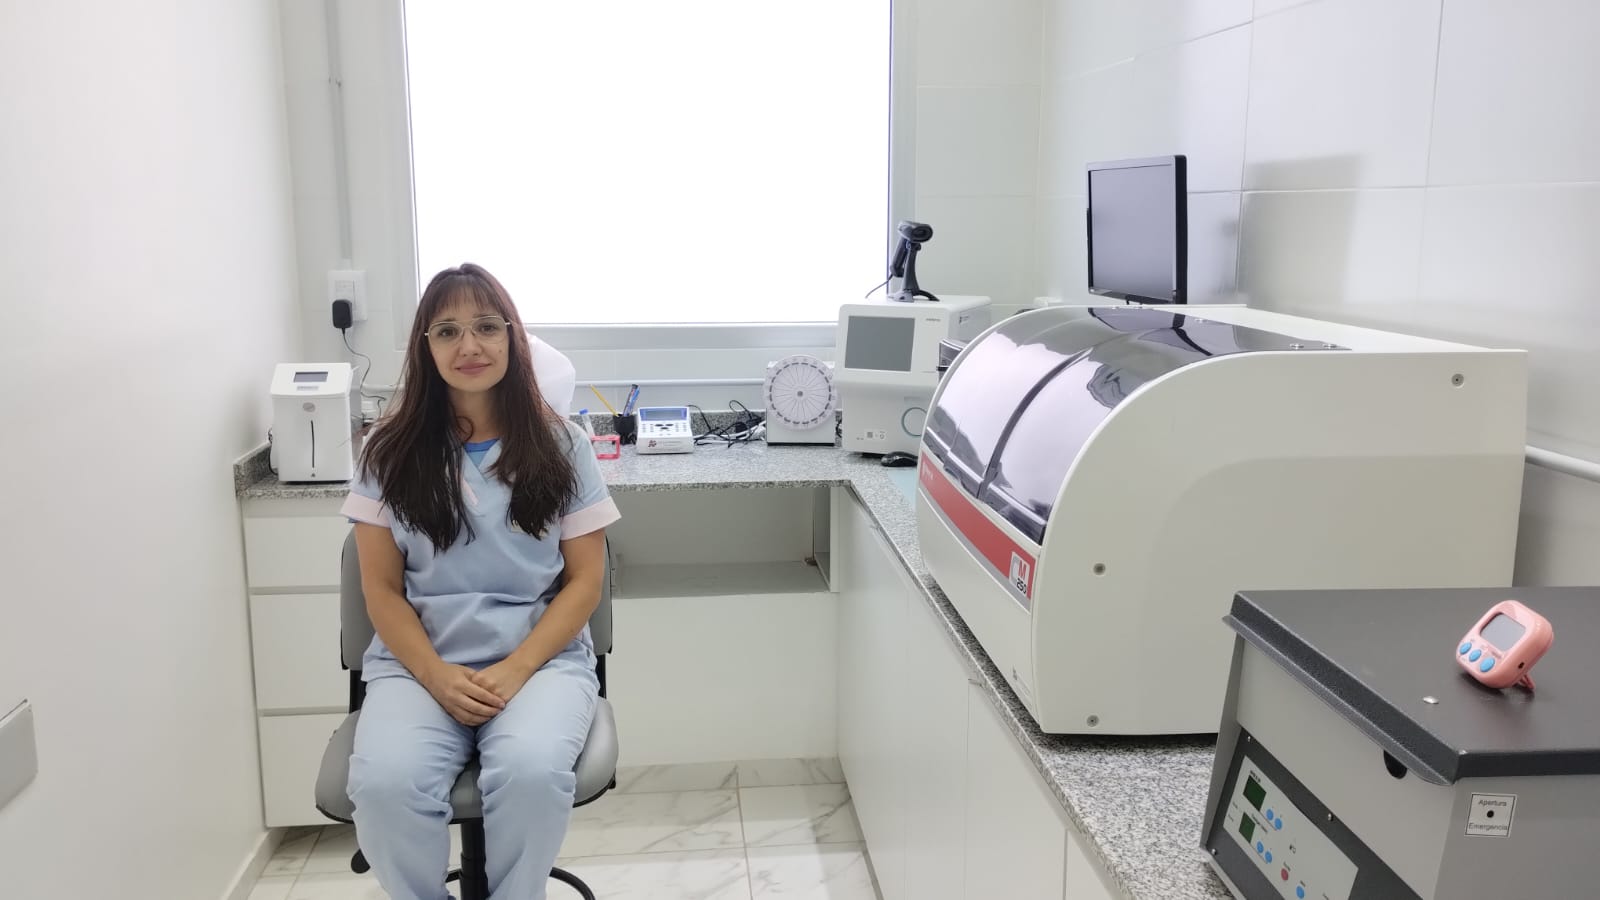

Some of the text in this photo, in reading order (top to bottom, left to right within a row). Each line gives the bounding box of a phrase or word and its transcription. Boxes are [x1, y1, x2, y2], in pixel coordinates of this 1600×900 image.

[1016, 577, 1027, 594] 250
[1478, 799, 1508, 808] Apertura
[1468, 822, 1508, 832] Emergencia
